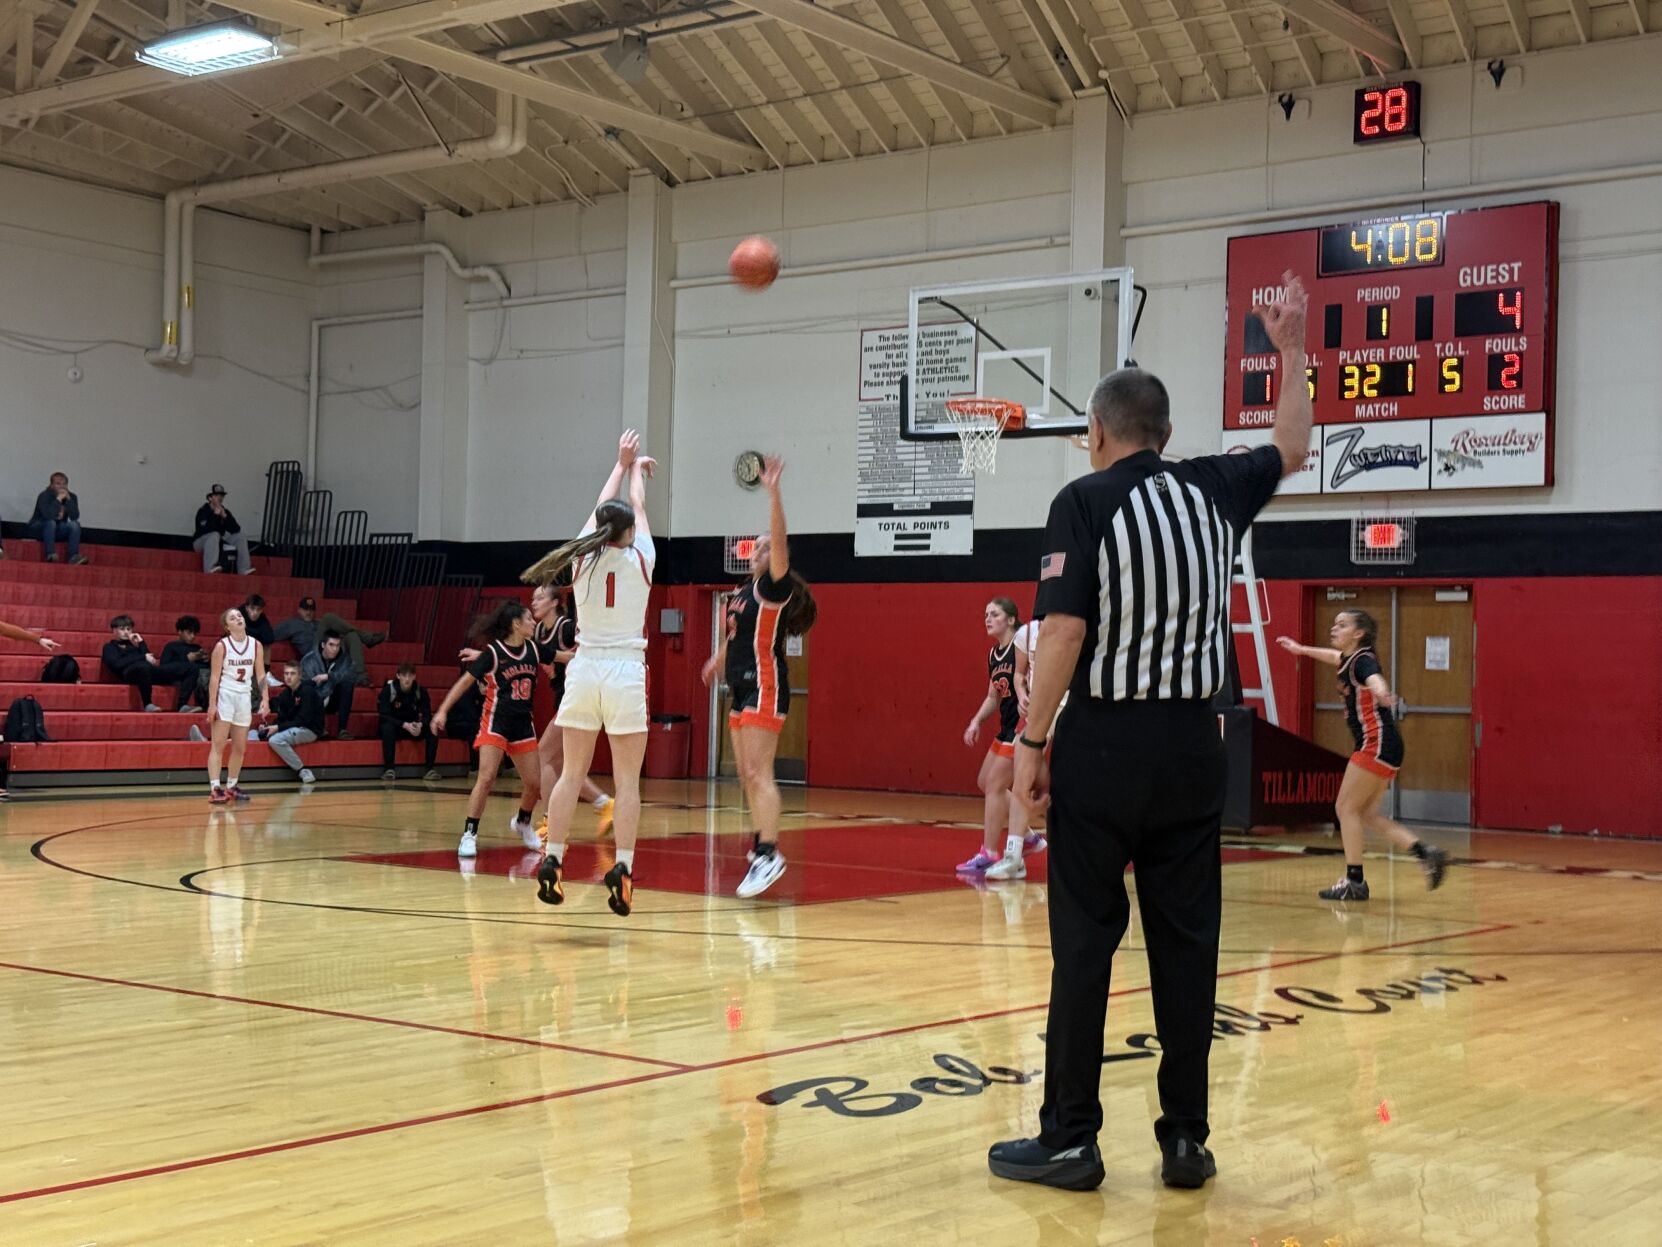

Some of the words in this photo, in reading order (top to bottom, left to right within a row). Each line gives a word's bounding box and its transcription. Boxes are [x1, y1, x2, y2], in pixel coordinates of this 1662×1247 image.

[1361, 88, 1407, 135] 28
[1351, 218, 1438, 265] 4:08
[1458, 262, 1522, 287] GUEST
[1252, 286, 1290, 306] HOM
[1357, 286, 1401, 303] PERIOD
[1498, 291, 1522, 329] 4
[1381, 307, 1388, 336] 1
[879, 334, 890, 342] The
[922, 329, 958, 339] businesses
[925, 339, 942, 347] cents
[944, 338, 955, 347] per
[956, 336, 973, 345] point
[921, 348, 933, 357] and
[935, 347, 950, 357] boys
[1434, 342, 1469, 357] T.O.L.
[1485, 336, 1527, 353] FOULS
[925, 357, 943, 366] home
[945, 356, 967, 365] games
[1339, 348, 1385, 364] PLAYER
[1389, 345, 1421, 361] FOUL
[1240, 356, 1277, 372] FOULS
[1501, 353, 1520, 389] 2
[863, 380, 885, 388] Please
[921, 376, 936, 385] your
[1344, 364, 1381, 399] 32
[1407, 363, 1414, 393] 1
[1442, 358, 1461, 392] 5
[1265, 374, 1271, 402] 1
[1355, 401, 1398, 419] MATCH
[1483, 394, 1526, 411] SCORE
[1239, 410, 1276, 425] SCORE
[1473, 448, 1500, 457] Builders
[1502, 447, 1526, 457] Supply
[878, 522, 908, 531] TOTAL
[913, 521, 950, 531] POINTS
[605, 572, 616, 608] 1
[236, 668, 246, 683] 2
